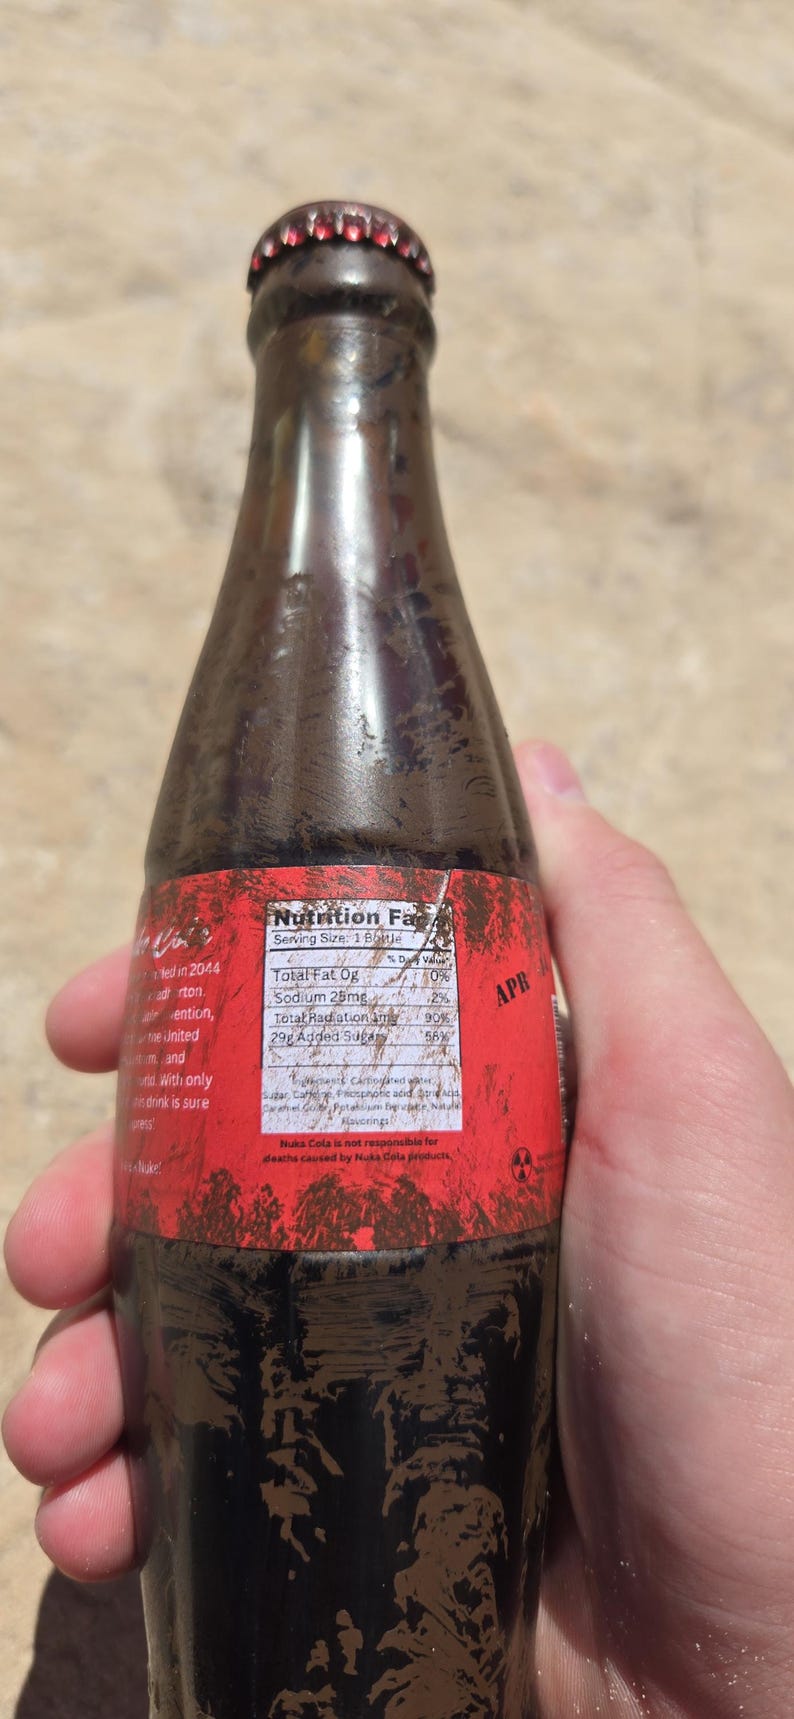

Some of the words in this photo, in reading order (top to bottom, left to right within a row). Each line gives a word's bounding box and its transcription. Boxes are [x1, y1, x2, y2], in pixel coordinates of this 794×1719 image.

[273, 934, 317, 945] Serving
[320, 933, 349, 943] Size:
[354, 933, 360, 943] 1
[189, 961, 221, 977] 2044
[273, 969, 308, 982] Total
[313, 969, 336, 981] Fat
[430, 970, 450, 982] 0%
[496, 971, 530, 1007] APR
[274, 992, 327, 1004] Sodium
[274, 1012, 305, 1024] Total
[163, 1028, 200, 1043] United
[271, 1031, 293, 1046] 29g
[297, 1031, 339, 1042] Added
[165, 1050, 186, 1064] and
[160, 1072, 183, 1087] With
[185, 1071, 213, 1091] only
[146, 1095, 169, 1109] drink
[171, 1094, 181, 1109] is
[182, 1096, 210, 1109] sure
[280, 1139, 306, 1148] Nuka
[308, 1139, 331, 1148] Cola
[334, 1139, 342, 1148] is
[345, 1139, 362, 1148] not
[364, 1136, 422, 1148] responsible
[425, 1136, 438, 1146] for
[263, 1153, 298, 1163] deaths
[301, 1153, 337, 1162] caused
[339, 1152, 352, 1164] by
[355, 1152, 381, 1162] Nuka
[383, 1152, 405, 1161] Cola
